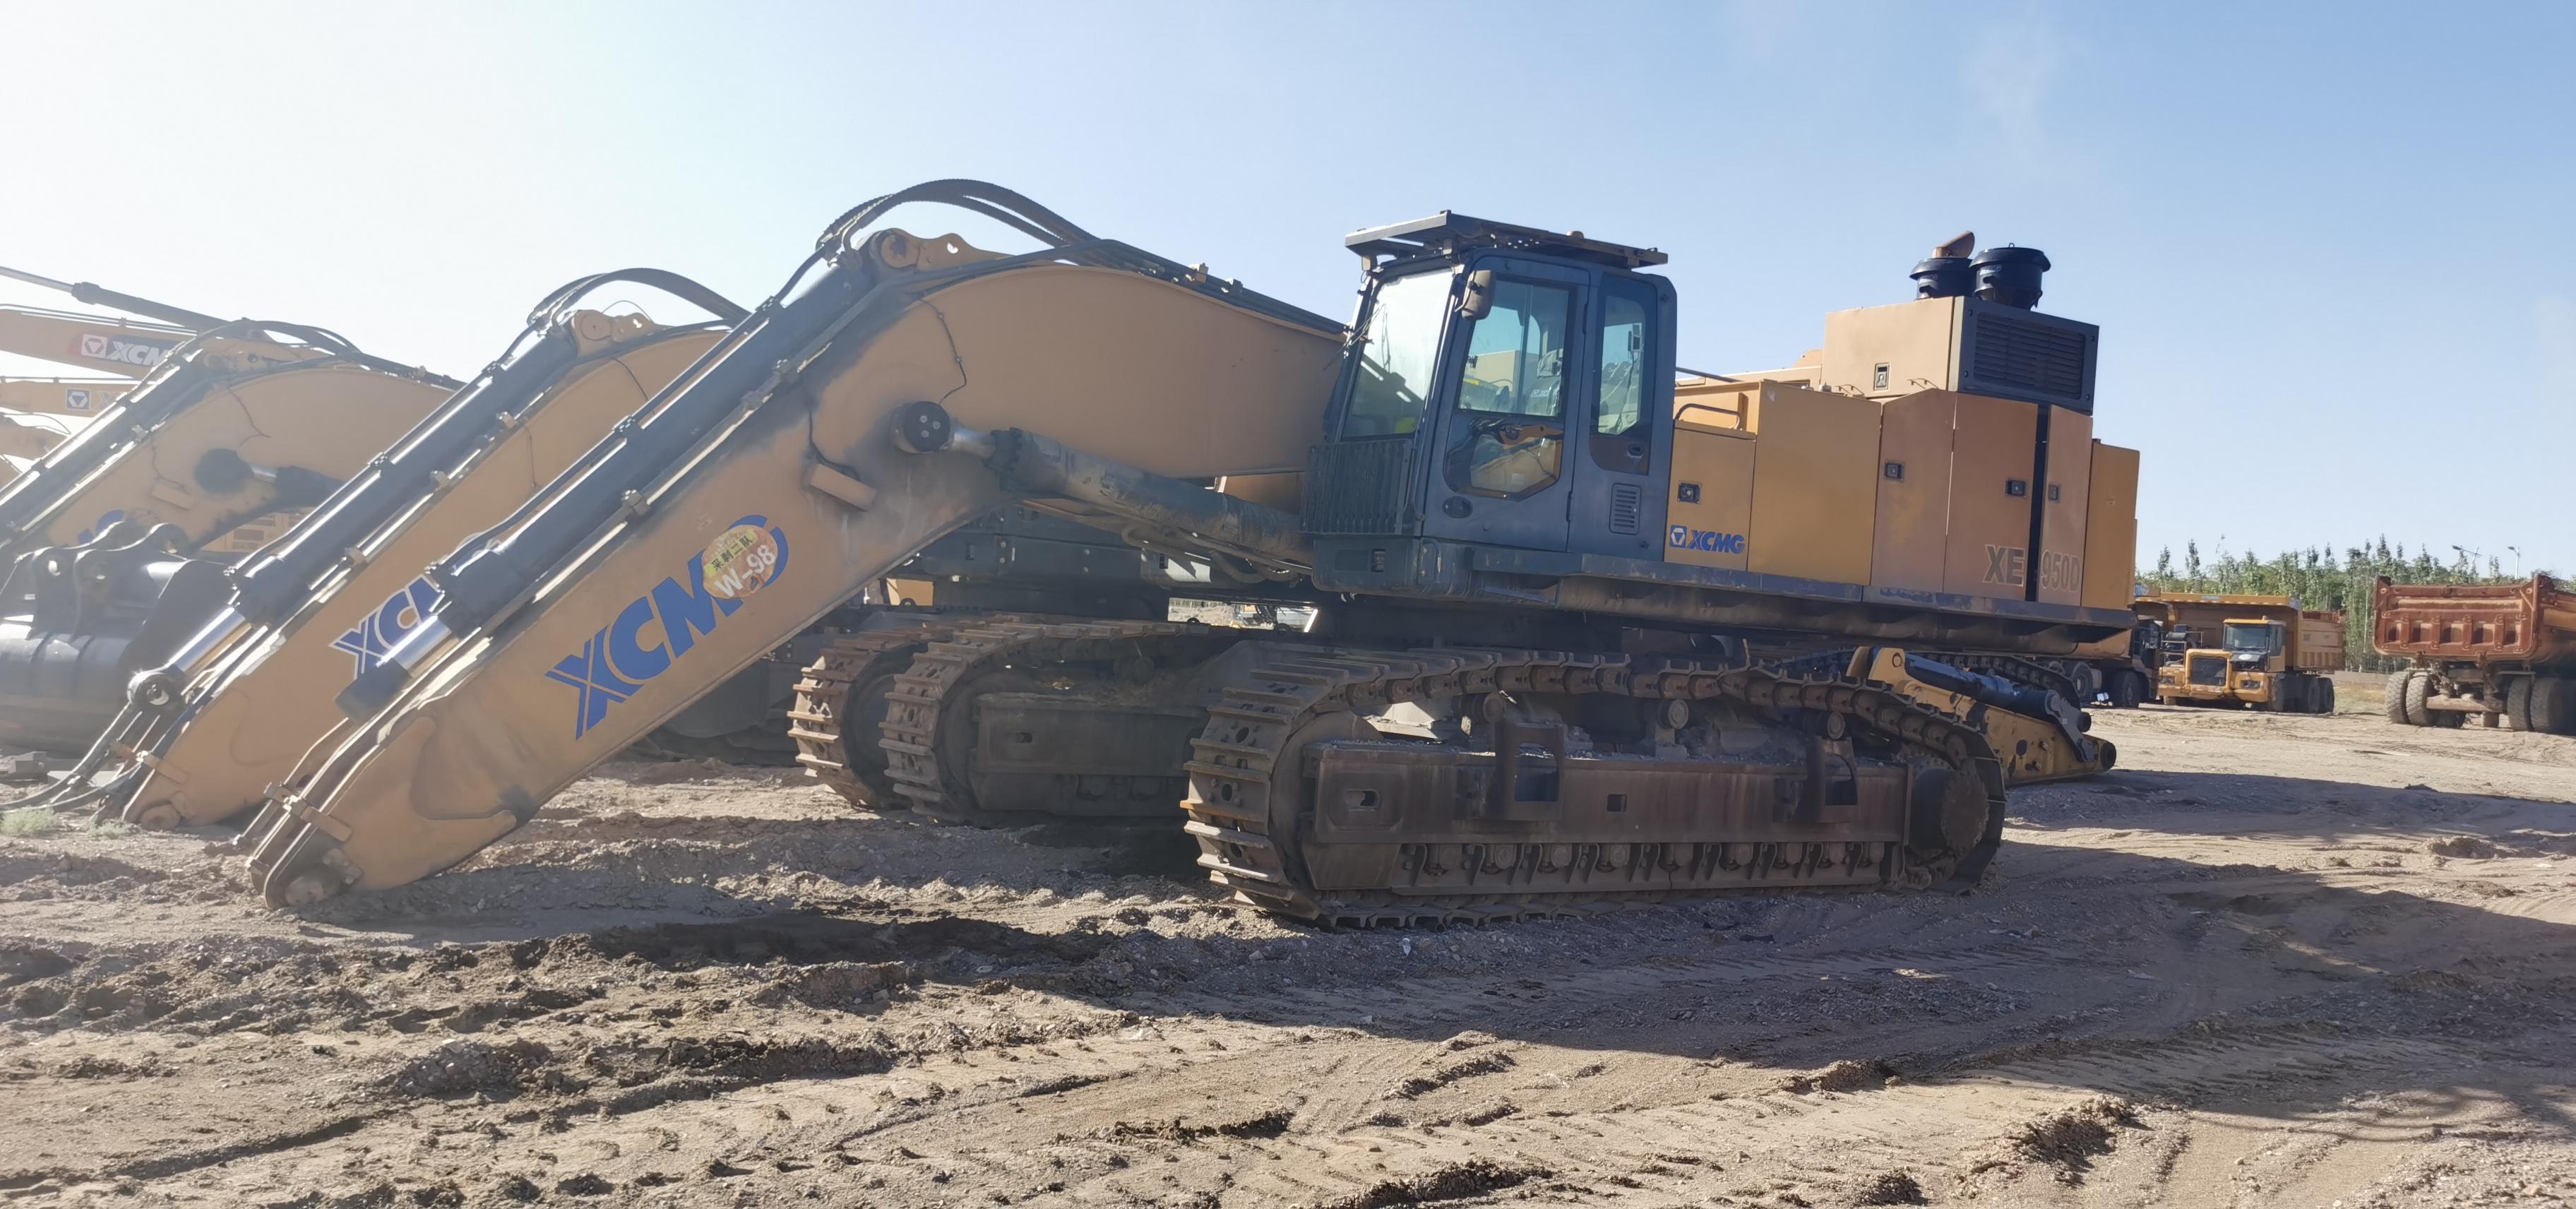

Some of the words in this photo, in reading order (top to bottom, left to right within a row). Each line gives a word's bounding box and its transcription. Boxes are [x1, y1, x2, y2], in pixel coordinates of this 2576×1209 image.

[106, 340, 171, 367] XCM
[1686, 530, 1746, 554] XCMG
[714, 544, 776, 597] W-98
[1982, 544, 2025, 587] XE
[2041, 549, 2081, 592] 950D
